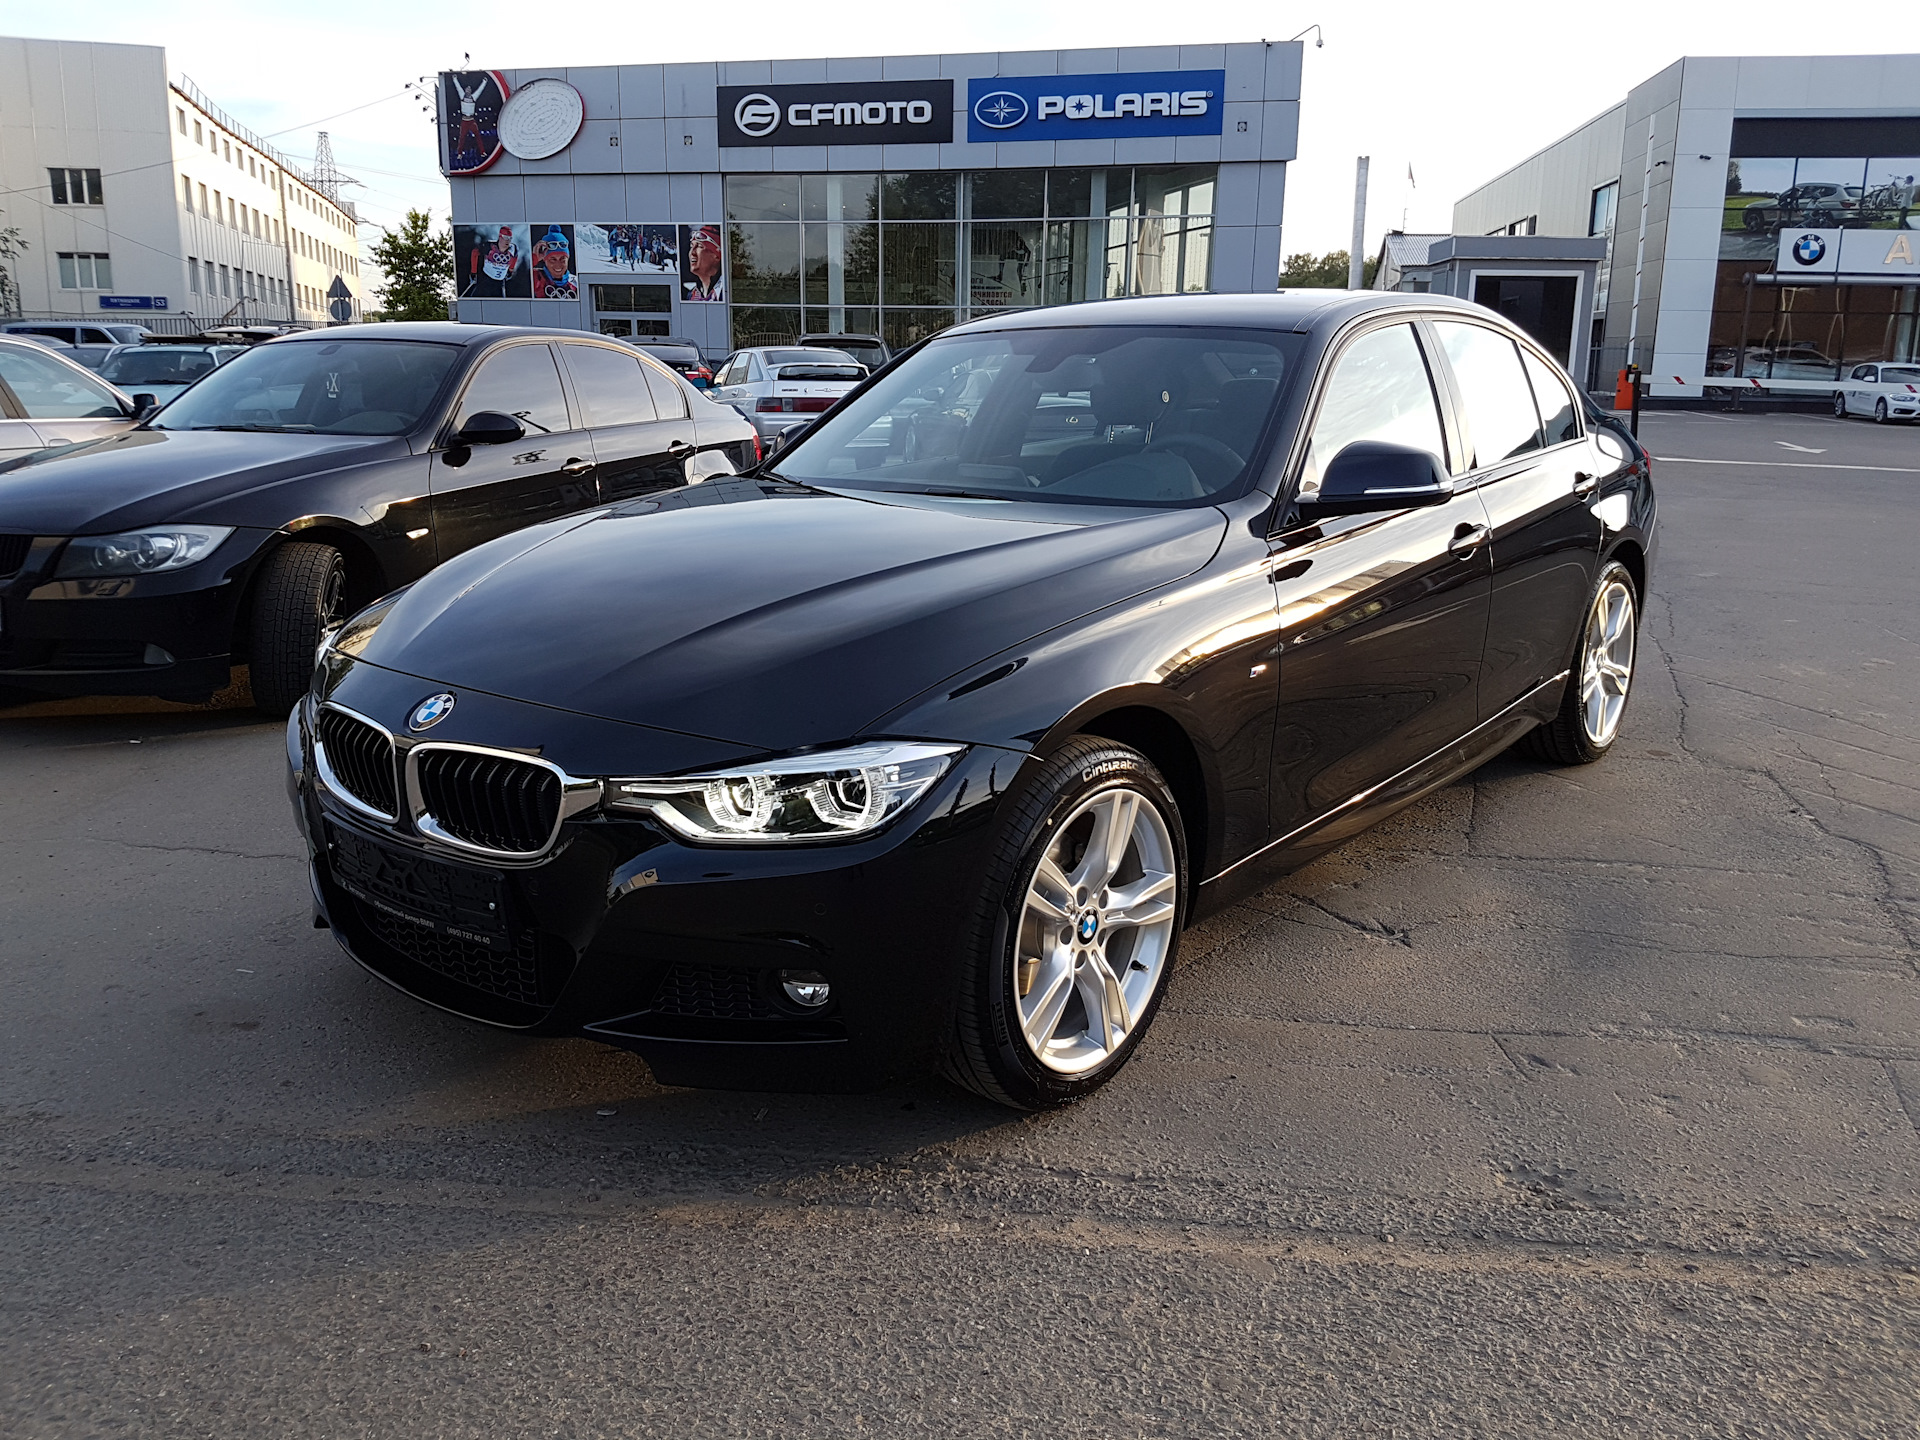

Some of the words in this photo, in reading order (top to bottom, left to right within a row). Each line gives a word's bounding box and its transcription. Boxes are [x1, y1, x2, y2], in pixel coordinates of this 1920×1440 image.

[788, 100, 932, 126] CFMOTO
[1037, 91, 1208, 121] POLARIS
[1082, 760, 1138, 783] Cinturato
[462, 931, 473, 940] 727
